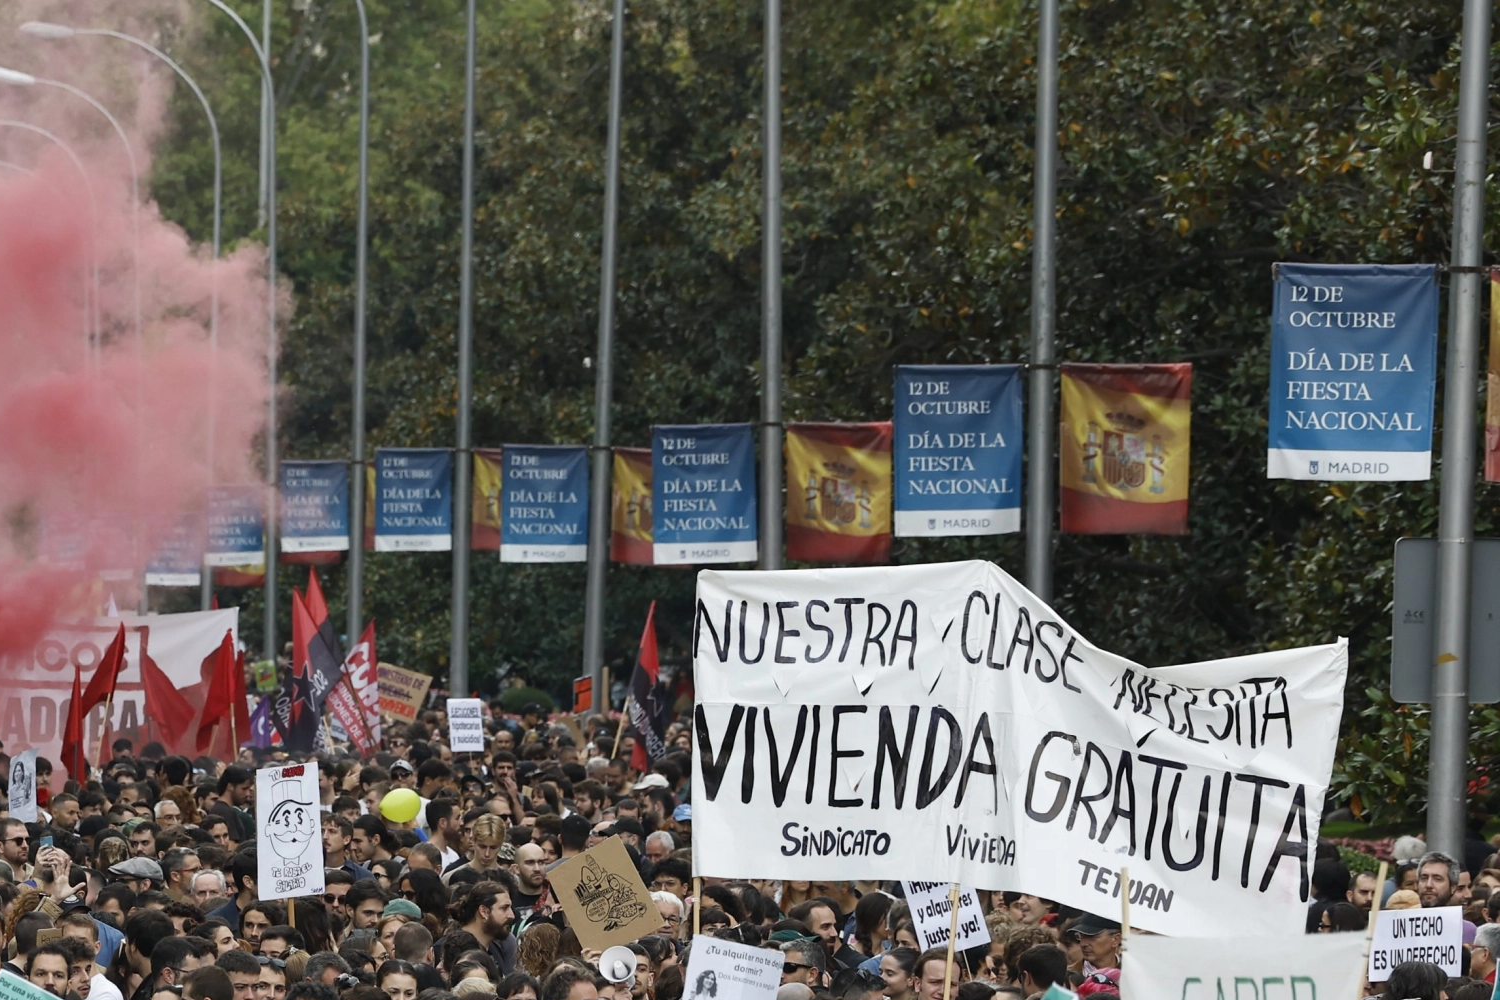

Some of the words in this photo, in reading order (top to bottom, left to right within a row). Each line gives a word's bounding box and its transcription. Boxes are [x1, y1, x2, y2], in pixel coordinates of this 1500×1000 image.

[1291, 286, 1309, 302] 12
[1315, 286, 1343, 302] DE
[1290, 312, 1395, 329] OCTUBRE
[1288, 350, 1333, 371] DÍA
[1340, 353, 1375, 371] DE
[1380, 353, 1414, 372] LA
[909, 382, 922, 395] 12
[926, 382, 949, 395] DE
[1287, 382, 1372, 401] FIESTA
[909, 401, 991, 415] OCTUBRE
[1285, 410, 1422, 431] NACIONAL
[676, 438, 696, 450] DE
[909, 431, 944, 449] DÍA
[949, 433, 976, 448] DE
[980, 432, 1006, 448] LA
[662, 453, 729, 466] OCTUBRE
[909, 457, 974, 472] FIESTA
[1329, 461, 1389, 475] MADRID
[663, 478, 691, 493] DÍA
[695, 479, 718, 493] DE
[721, 479, 742, 492] LA
[909, 478, 1013, 495] NACIONAL
[663, 499, 717, 512] FIESTA
[663, 517, 750, 531] NACIONAL
[943, 517, 990, 529] MADRID
[692, 549, 730, 558] MADRID
[694, 597, 918, 671] NUESTRA
[960, 590, 1085, 693] CLASE
[1112, 668, 1294, 750] NECESITA
[412, 676, 426, 691] DE
[695, 704, 999, 811] VIVIENDA
[1024, 730, 1309, 902] GRATUITA
[1078, 858, 1175, 913] TETUAN
[917, 907, 925, 924] y
[961, 914, 981, 939] ya!
[1393, 918, 1406, 939] UN
[1409, 916, 1443, 937] TECHO
[705, 946, 721, 955] ¿Tu
[722, 949, 755, 962] alquiler
[1373, 950, 1387, 970] ES
[1390, 949, 1404, 969] UN
[1407, 945, 1458, 966] DERECHO.
[718, 972, 731, 980] Dos
[734, 964, 763, 977] dormir?
[12, 984, 26, 997] una
